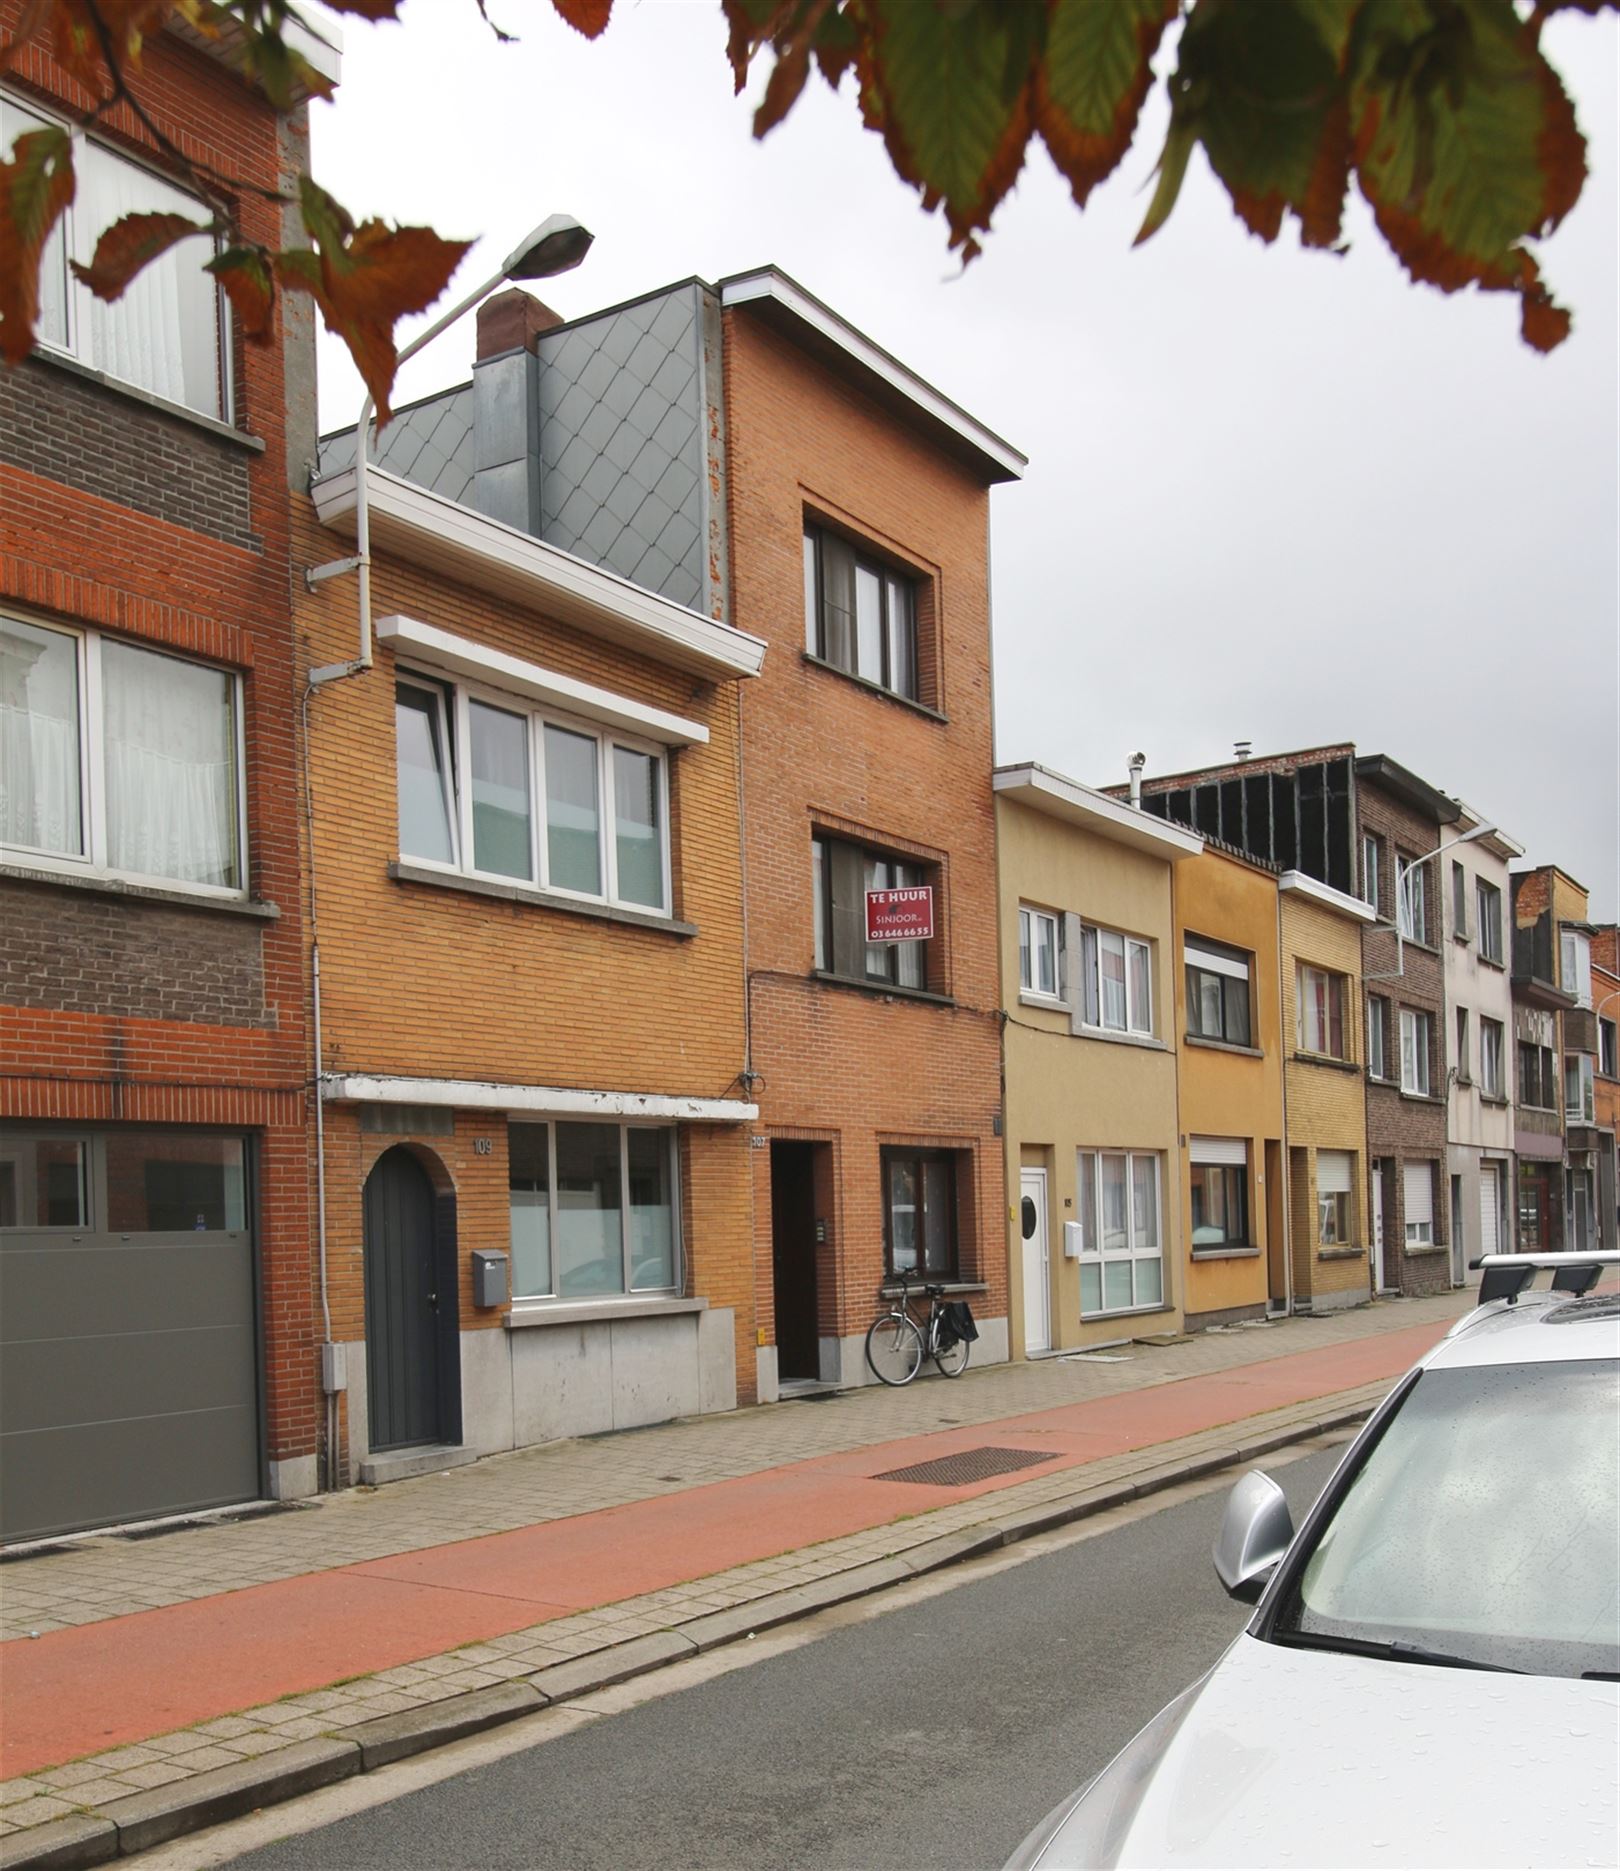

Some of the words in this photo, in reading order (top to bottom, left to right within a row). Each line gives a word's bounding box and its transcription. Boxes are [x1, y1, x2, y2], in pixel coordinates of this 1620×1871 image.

[870, 893, 885, 904] TE
[889, 890, 927, 902] HUUR
[475, 1137, 492, 1155] 109
